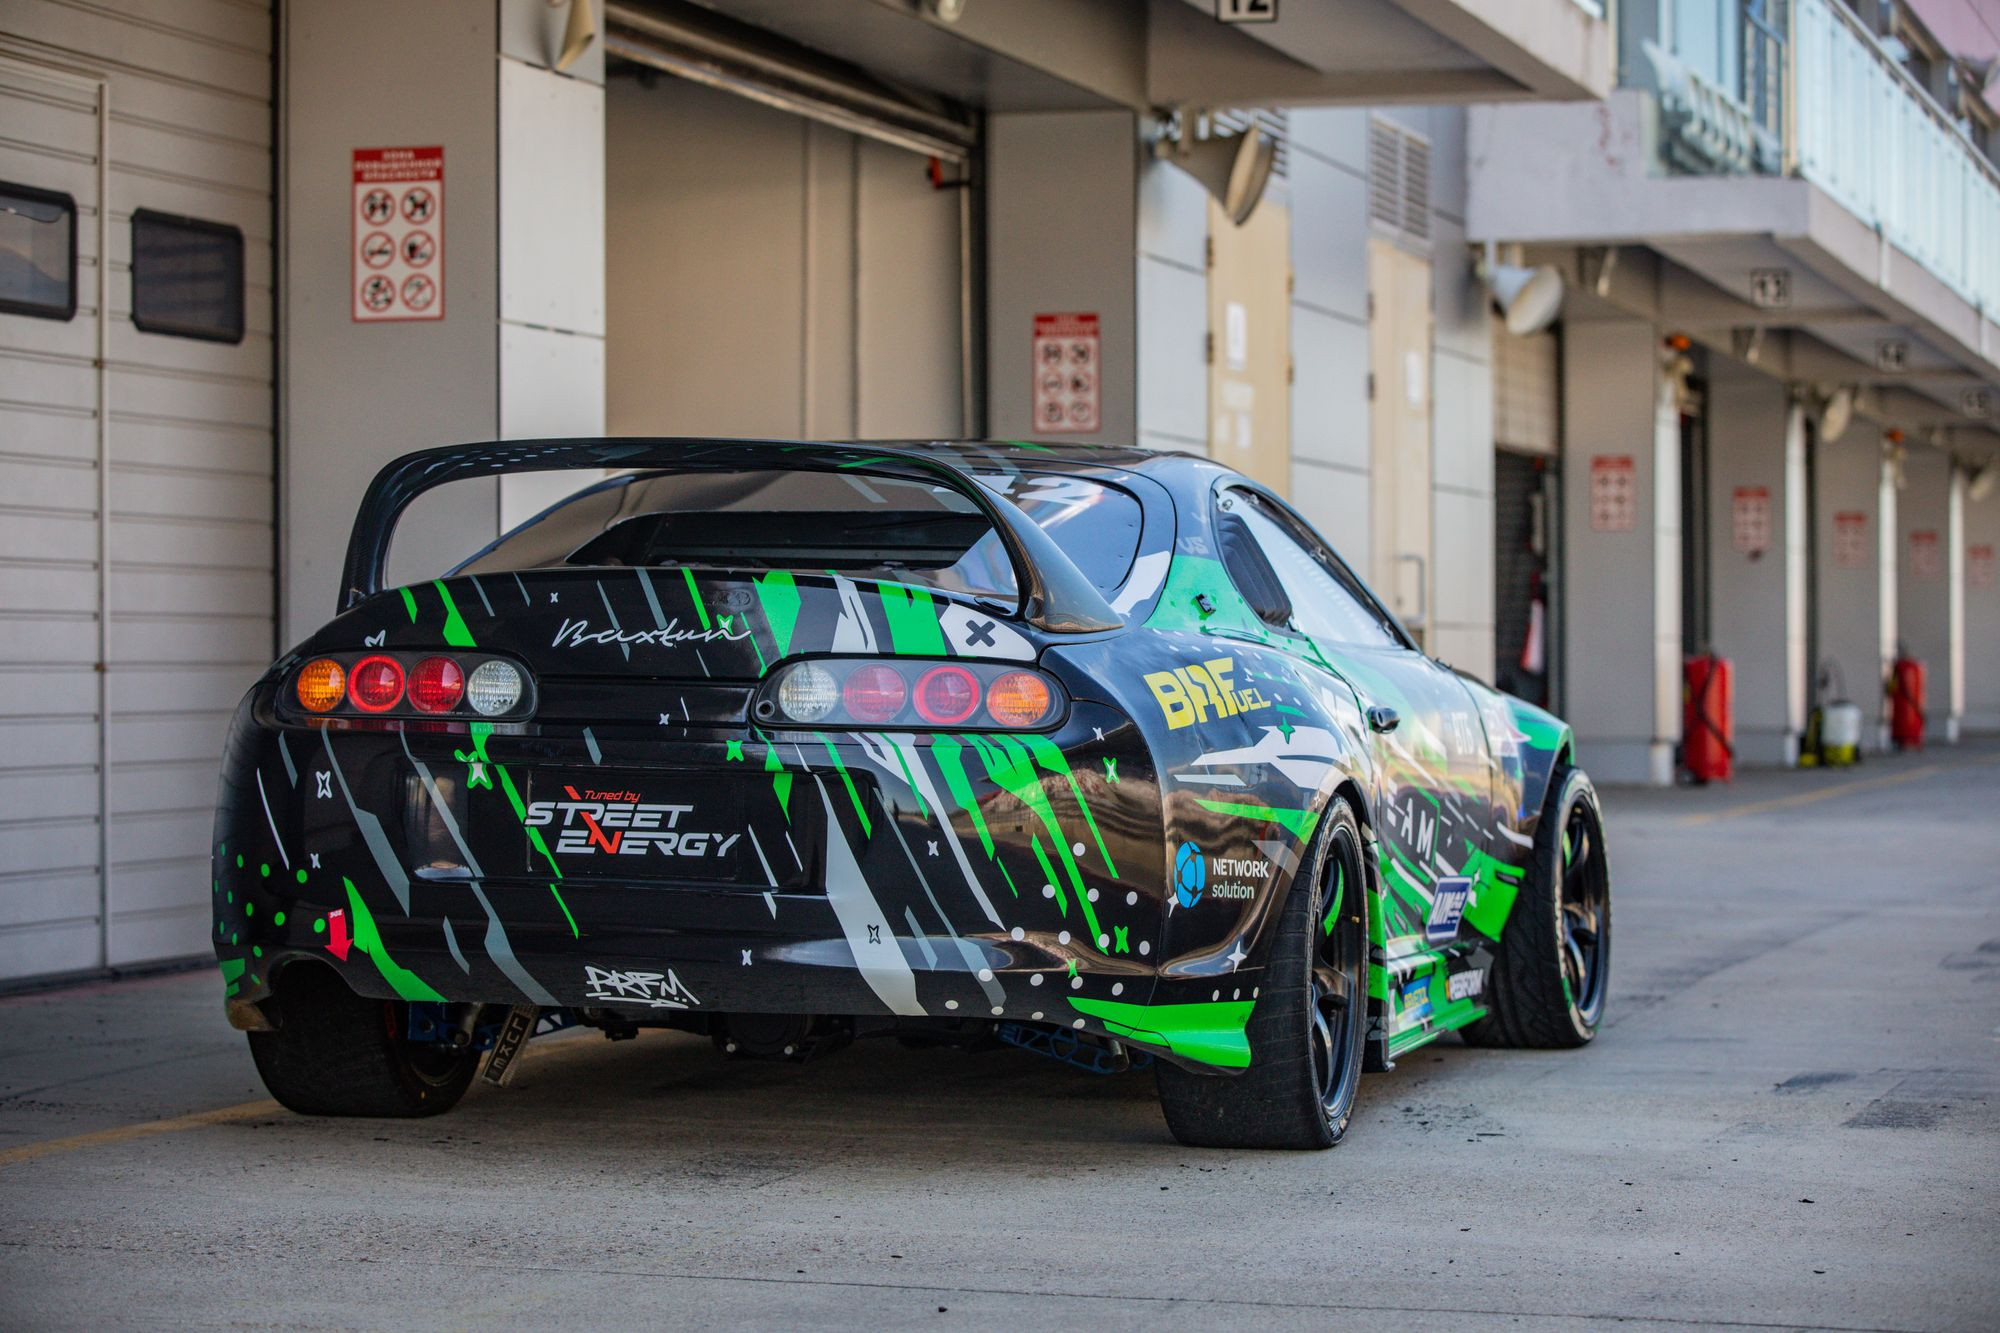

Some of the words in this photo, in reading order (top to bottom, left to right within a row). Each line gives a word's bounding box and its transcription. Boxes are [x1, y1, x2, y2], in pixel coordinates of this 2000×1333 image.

[584, 790, 622, 801] Tuned
[624, 791, 641, 803] by
[524, 801, 694, 829] STREET
[556, 828, 741, 857] ENERGY
[1212, 858, 1269, 878] NETWORK
[1212, 881, 1254, 899] solution
